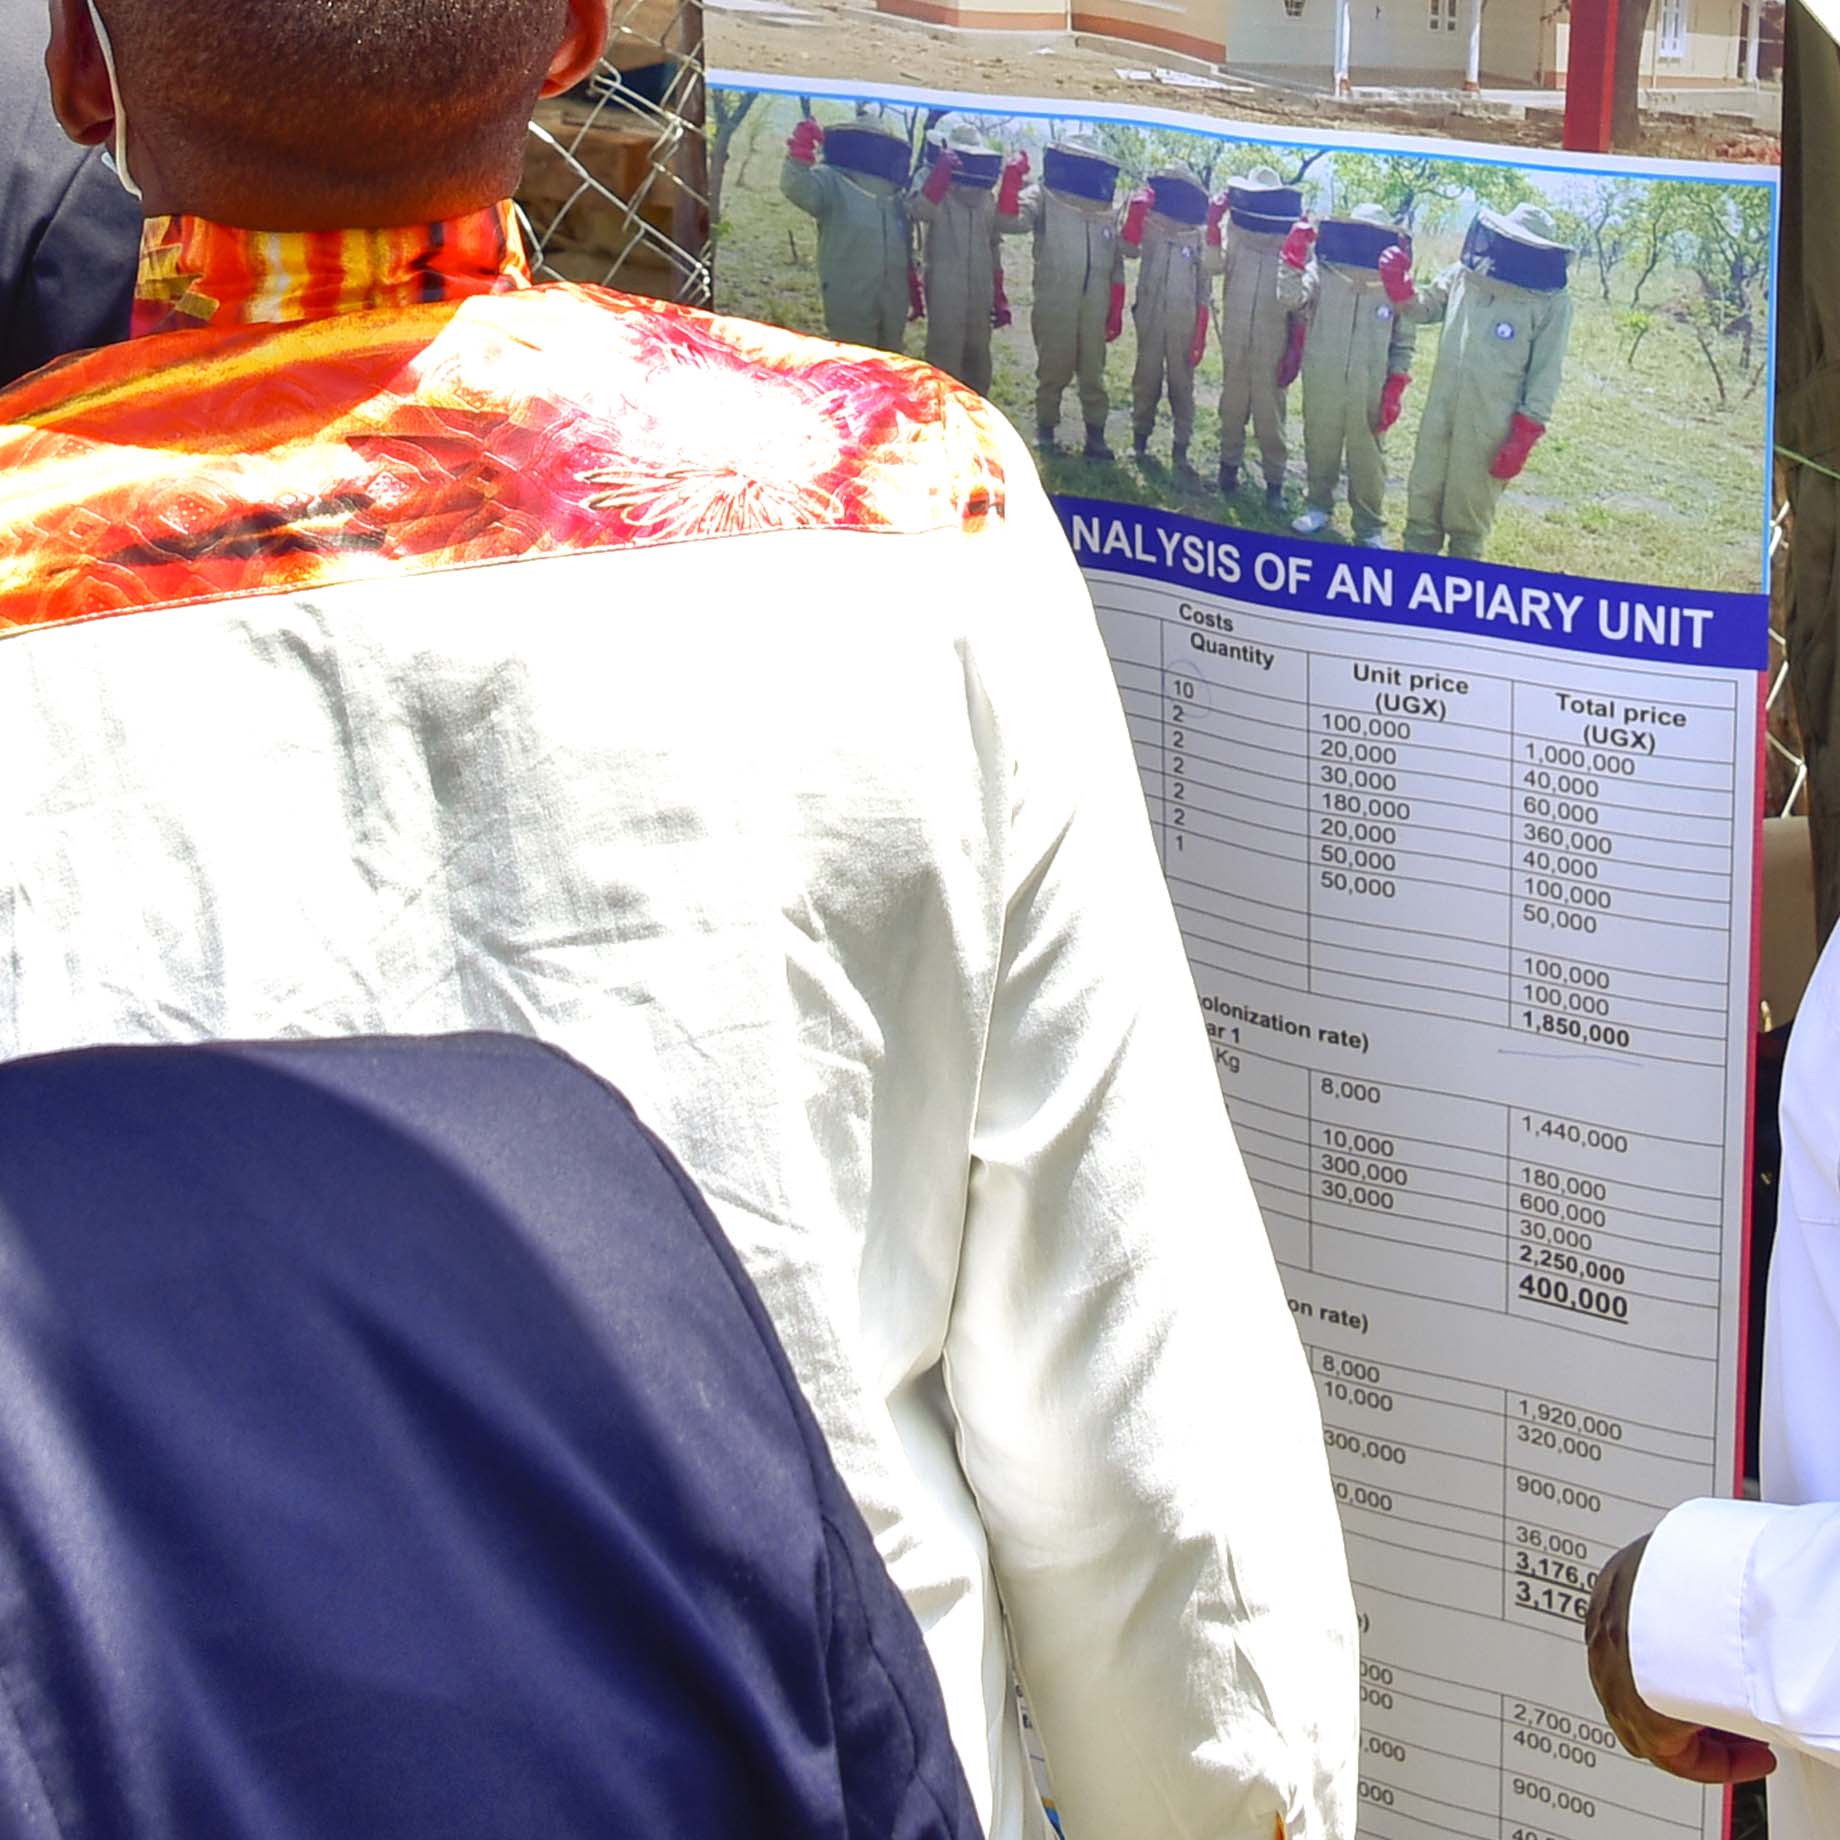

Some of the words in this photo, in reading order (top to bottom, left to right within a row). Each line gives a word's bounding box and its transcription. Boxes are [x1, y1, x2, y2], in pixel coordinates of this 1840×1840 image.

[1254, 551, 1313, 595] OF
[1325, 563, 1394, 607] AN
[1407, 571, 1585, 634] APIARY
[1598, 598, 1715, 649] UNIT
[1178, 603, 1234, 632] Costs
[1190, 631, 1275, 670] Quantity
[1173, 679, 1195, 700] 10
[1352, 662, 1403, 687] Unit
[1409, 669, 1470, 697] price
[1172, 704, 1185, 723] 2
[1374, 693, 1448, 722] (UGX)
[1555, 692, 1615, 719] Total
[1622, 700, 1688, 728] price
[1172, 730, 1185, 749] 2
[1321, 713, 1411, 740] 100,000
[1582, 724, 1657, 756] (UGX)
[1172, 756, 1185, 775] 2
[1320, 739, 1397, 765] 20,000
[1524, 742, 1636, 776] 1,000,000
[1172, 782, 1185, 800] 2
[1320, 765, 1397, 791] 30,000
[1523, 770, 1599, 798] 40,000
[1172, 808, 1185, 827] 2
[1321, 792, 1411, 820] 180,000
[1523, 796, 1599, 825] 60,000
[1175, 834, 1184, 851] 1
[1320, 818, 1397, 845] 20,000
[1523, 822, 1613, 854] 360,000
[1320, 844, 1396, 871] 50,000
[1523, 850, 1598, 879] 40,000
[1320, 871, 1396, 898] 50,000
[1523, 877, 1612, 909] 100,000
[1522, 904, 1597, 934] 50,000
[1523, 957, 1610, 989] 100,000
[1523, 983, 1610, 1016] 100,000
[1199, 994, 1312, 1039] olonization
[1318, 1028, 1370, 1055] rate)
[1231, 1027, 1241, 1043] 1
[1522, 1010, 1630, 1048] 1,850,000
[1216, 1047, 1241, 1073] Kg
[1320, 1076, 1382, 1104] 8,000
[1322, 1128, 1395, 1158] 10,000
[1522, 1114, 1628, 1153] 1,440,000
[1321, 1153, 1408, 1186] 300,000
[1521, 1166, 1607, 1201] 180,000
[1321, 1179, 1395, 1210] 30,000
[1519, 1192, 1606, 1228] 600,000
[1519, 1219, 1592, 1251] 30,000
[1519, 1244, 1625, 1286] 2,250,000
[1519, 1273, 1629, 1320] 400,000
[1319, 1304, 1369, 1335] rate)
[1322, 1354, 1381, 1384] 8,000
[1323, 1380, 1393, 1412] 10,000
[1518, 1399, 1623, 1441] 1,920,000
[1323, 1428, 1407, 1465] 300,000
[1516, 1424, 1603, 1462] 320,000
[1333, 1481, 1393, 1512] 0,000
[1516, 1474, 1602, 1513] 900,000
[1516, 1525, 1588, 1561] 36,000
[1513, 1702, 1617, 1750] 2,700,000
[1513, 1729, 1597, 1769] 400,000
[1512, 1776, 1596, 1820] 900,000
